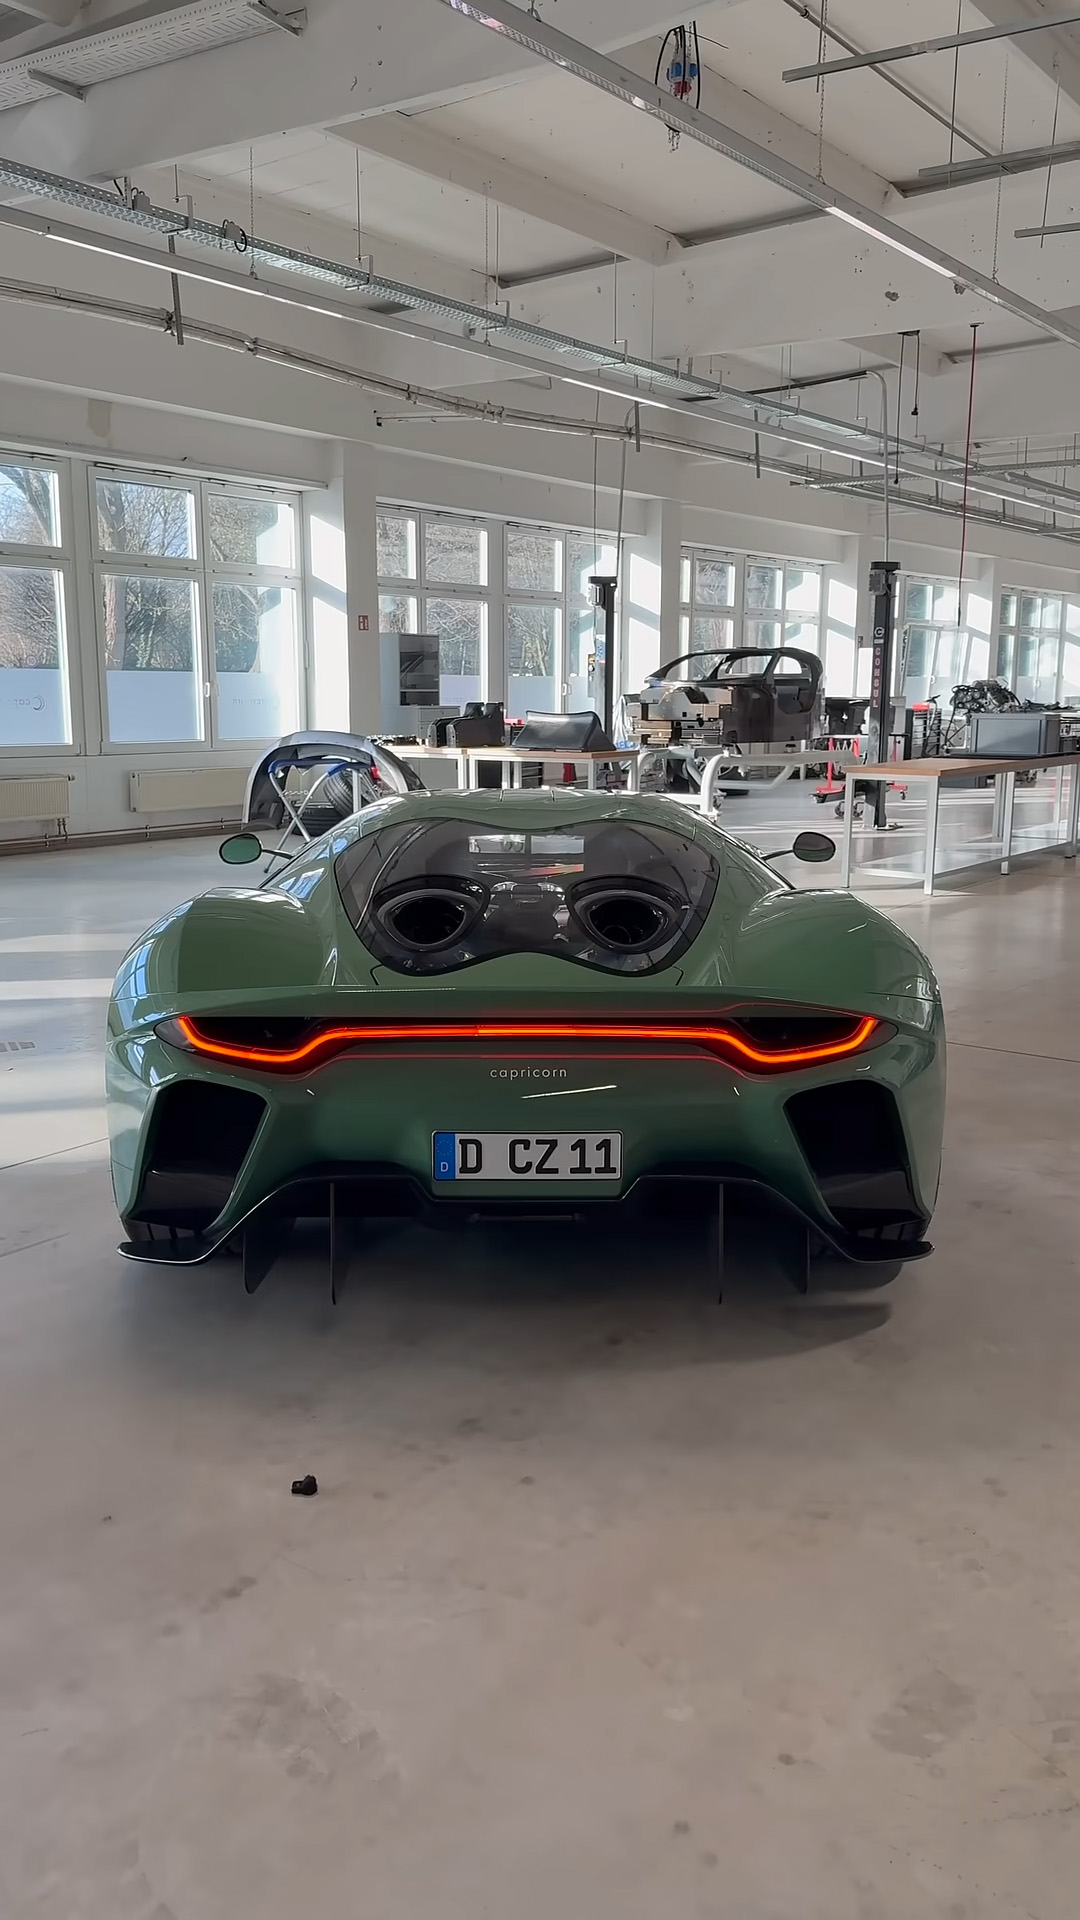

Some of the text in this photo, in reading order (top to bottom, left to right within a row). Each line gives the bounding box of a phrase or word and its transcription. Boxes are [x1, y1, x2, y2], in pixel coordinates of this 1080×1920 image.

[490, 1066, 568, 1081] capricorn
[458, 1138, 617, 1175] D CZ 11
[440, 1161, 449, 1173] D
